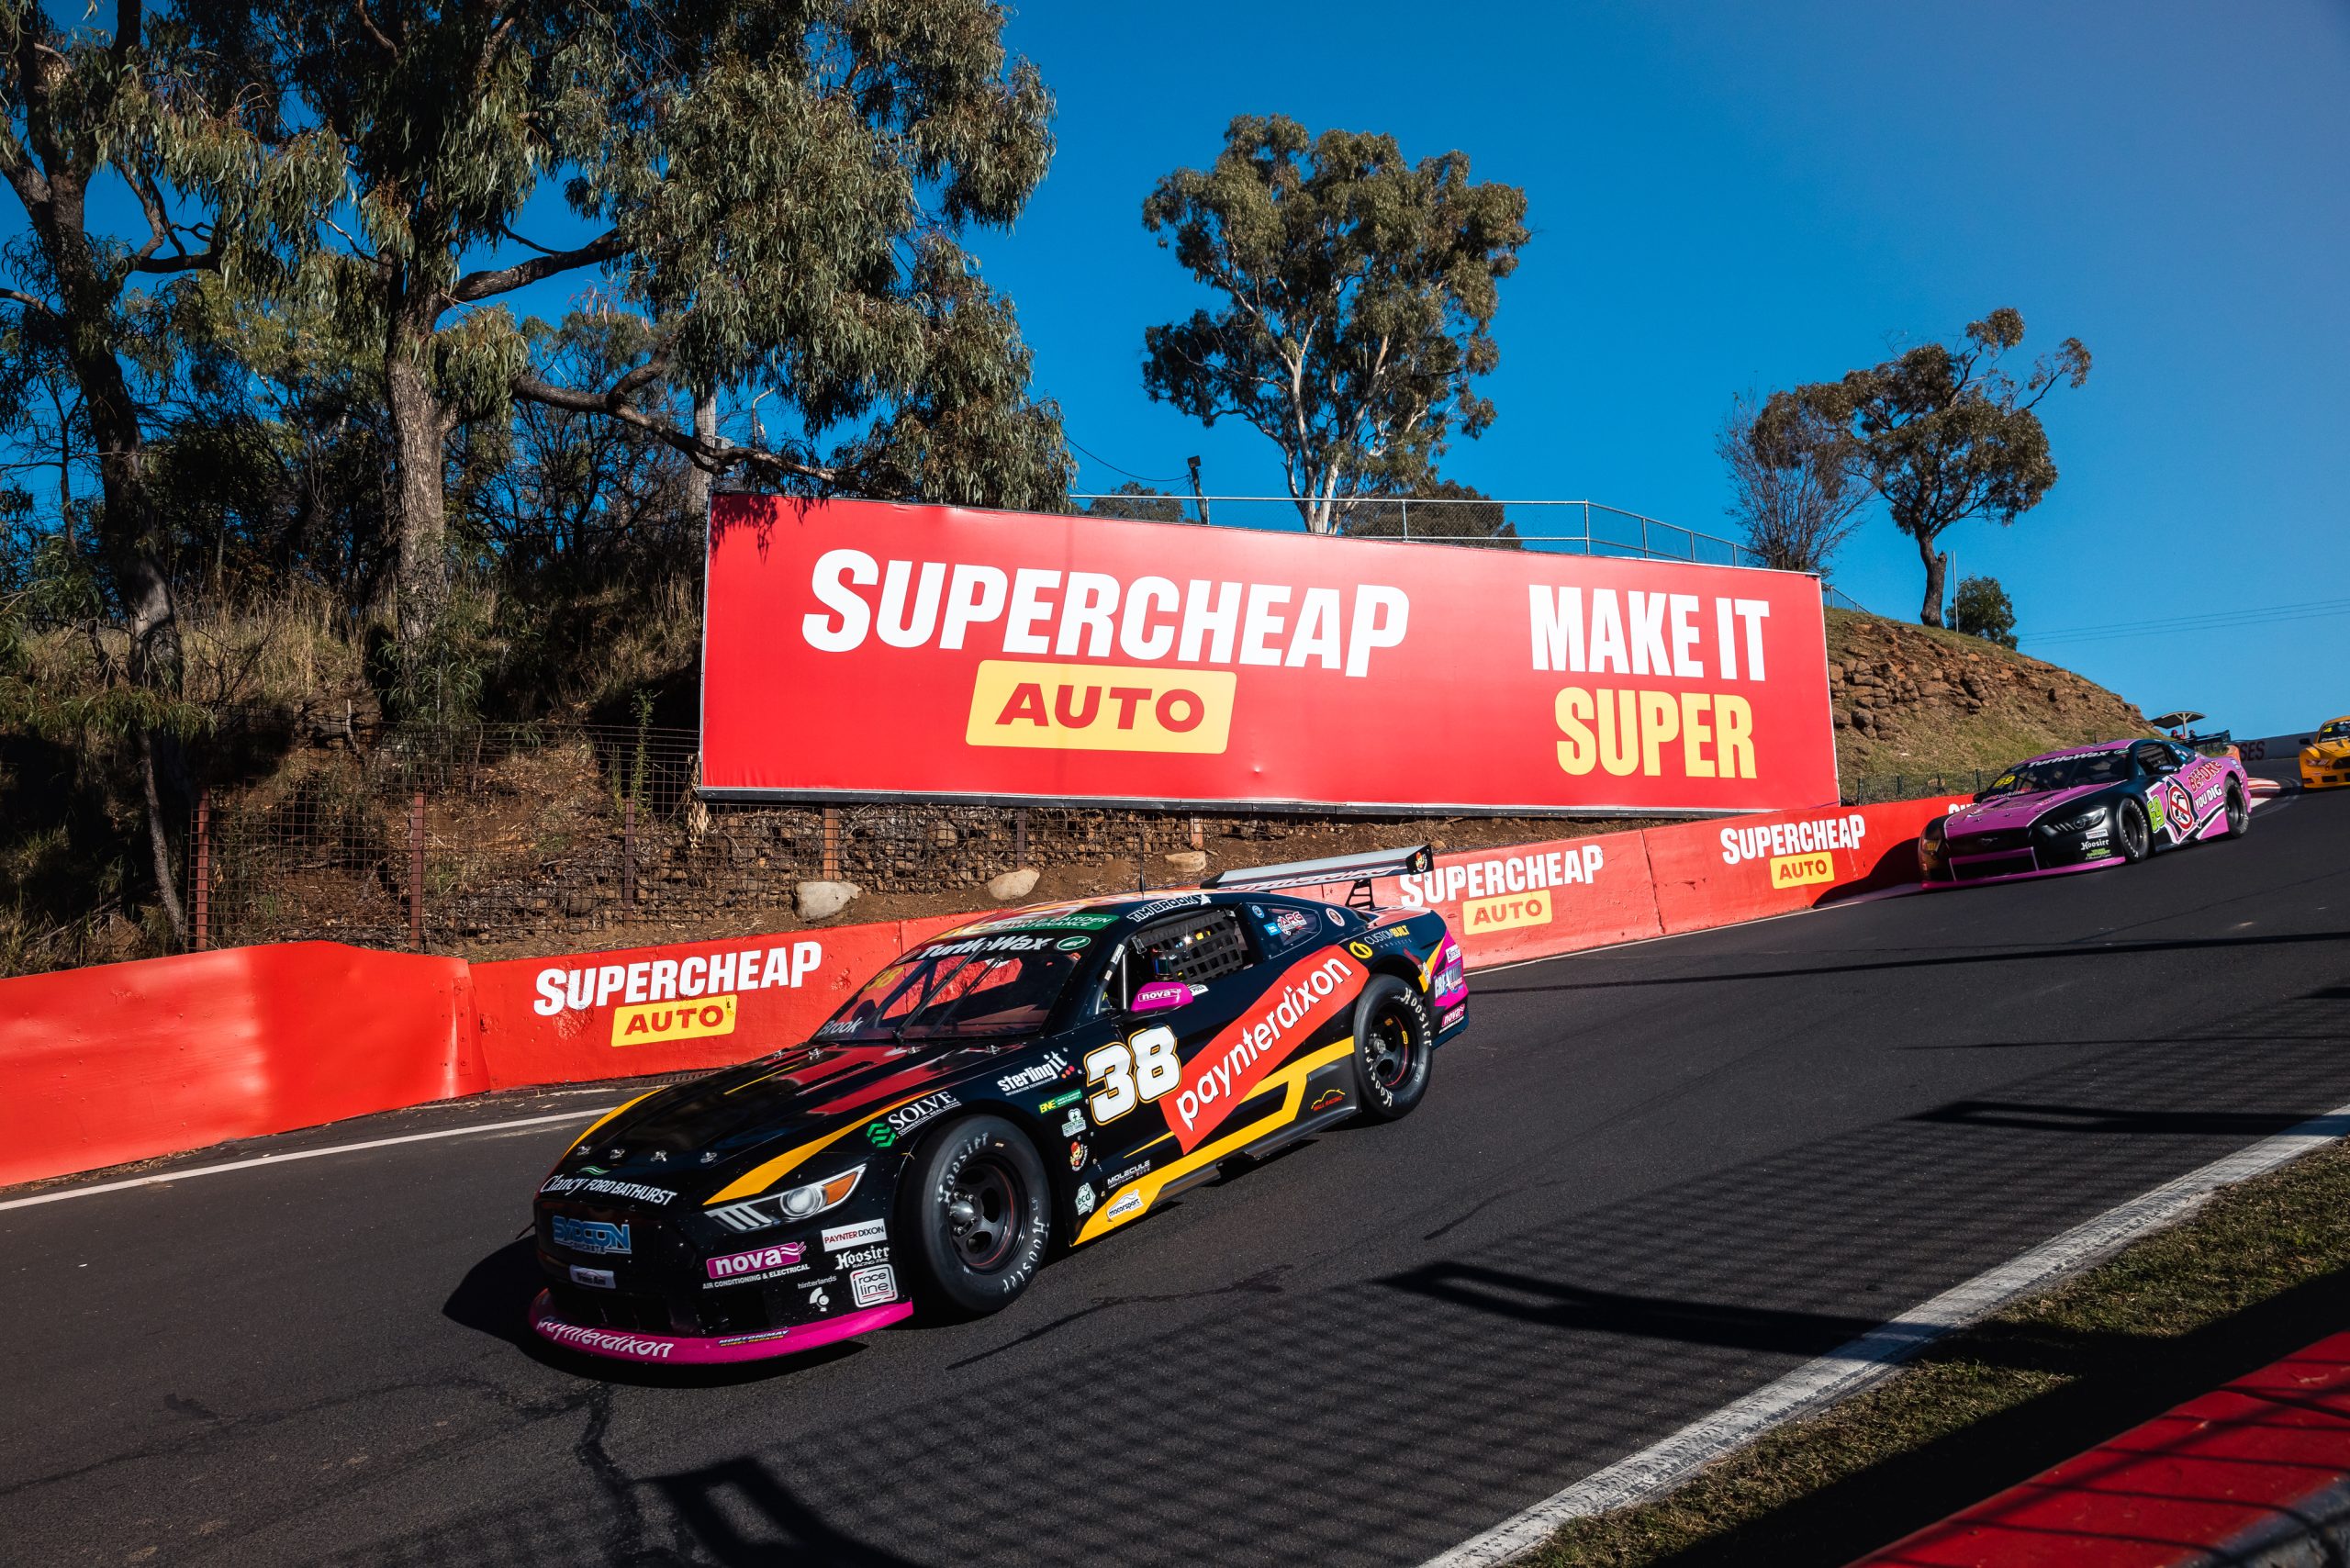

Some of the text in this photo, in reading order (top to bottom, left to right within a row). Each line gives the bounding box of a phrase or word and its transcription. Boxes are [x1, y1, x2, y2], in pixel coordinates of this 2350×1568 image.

[801, 548, 1410, 678] SUPERCHEAP
[1528, 584, 1770, 681] MAKE IT
[995, 682, 1205, 734] AUTO
[1554, 686, 1757, 779] SUPER
[2237, 740, 2266, 761] SES
[1993, 775, 2016, 787] 69
[2188, 760, 2224, 793] BEFORE
[2195, 784, 2222, 810] YOU DIG
[2146, 795, 2165, 833] 69
[1720, 814, 1866, 865] SUPERCHEAP
[2080, 838, 2109, 851] Hoosier
[1399, 845, 1604, 907] SUPERCHEAP
[1779, 858, 1828, 880] AUTO
[1126, 895, 1199, 923] TIM BROOK
[1473, 899, 1543, 926] AUTO
[533, 941, 822, 1016] SUPERCHEAP
[1141, 990, 1171, 1001] nova
[624, 1005, 723, 1036] AUTO
[816, 1016, 864, 1036] Brook
[1444, 1009, 1461, 1025] nova
[1175, 957, 1353, 1131] paynterdixon
[1083, 1025, 1182, 1126] 38
[888, 1091, 957, 1130] SOLVE
[898, 1101, 961, 1135] COMMERCIAL REAL ESTATE
[1039, 1100, 1057, 1114] BNE
[540, 1174, 589, 1195] Clancy
[552, 1215, 631, 1249] SYDCON
[714, 1247, 782, 1275] nova
[834, 1245, 890, 1271] Hoosier
[702, 1282, 714, 1290] AIR
[714, 1275, 761, 1287] CONDITIONING
[769, 1263, 811, 1278] ELECTRICAL
[797, 1274, 837, 1290] hinterlands
[858, 1272, 887, 1283] race
[860, 1282, 890, 1295] line
